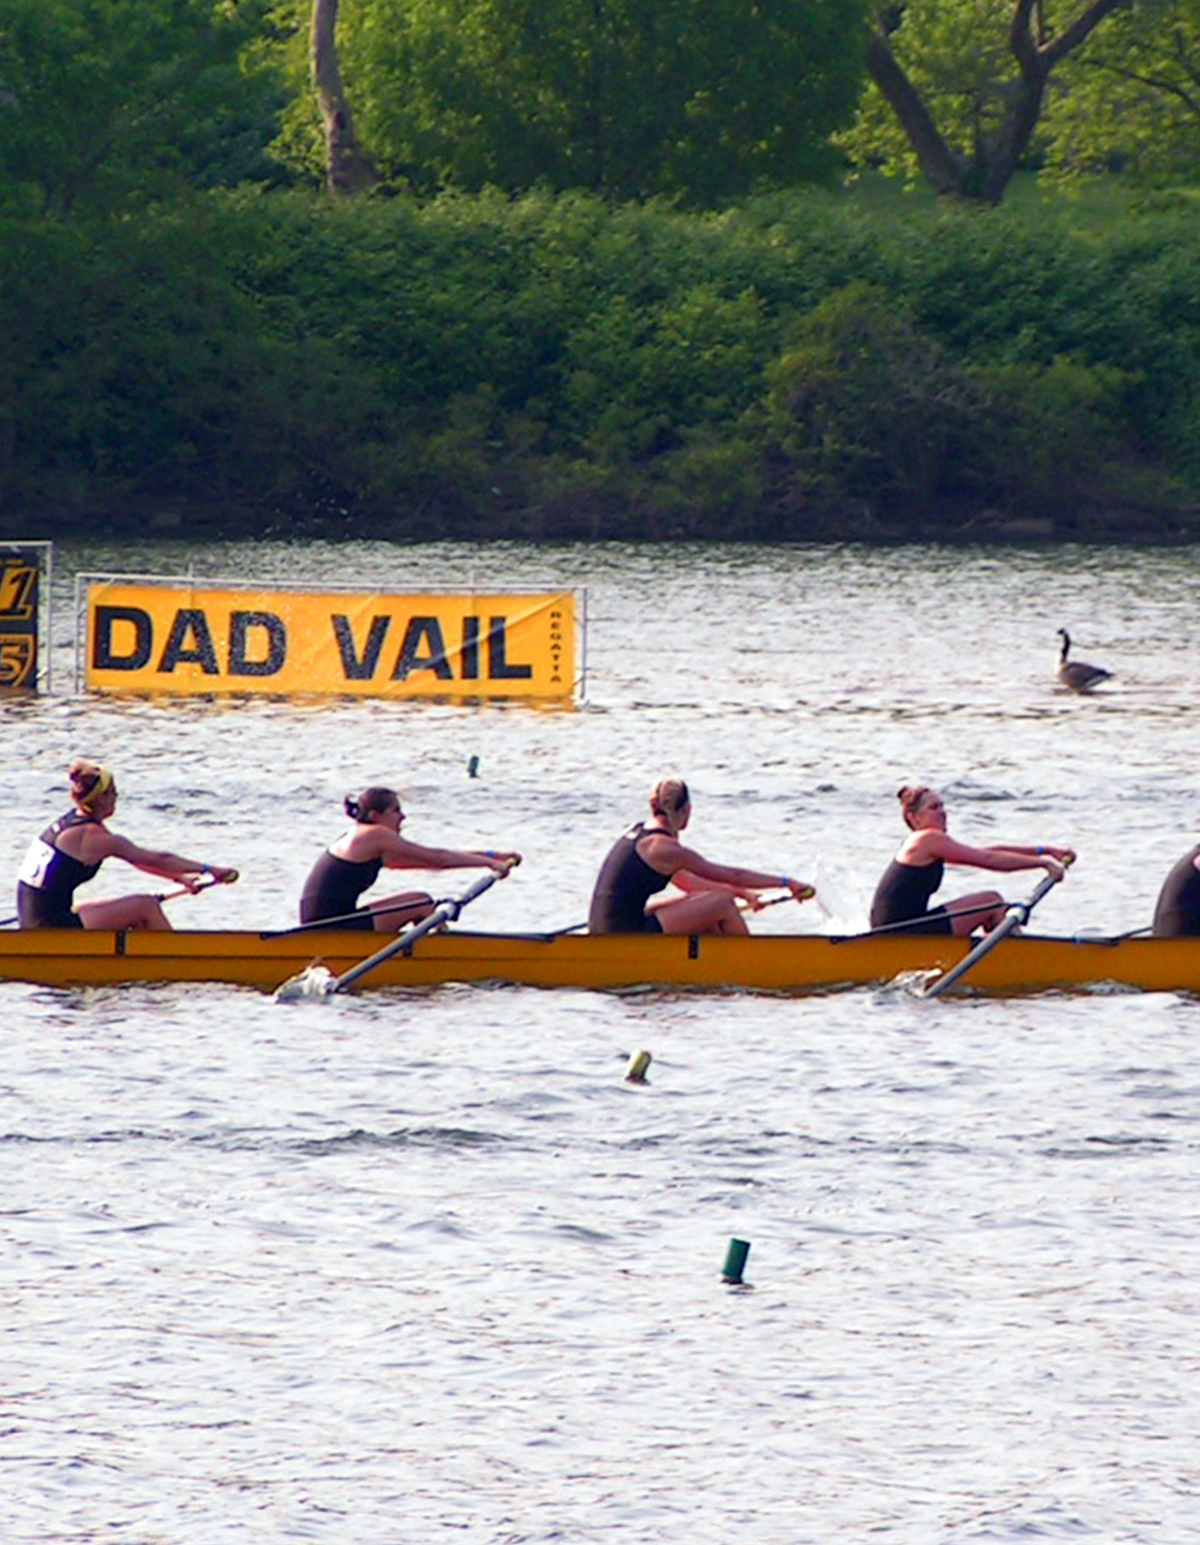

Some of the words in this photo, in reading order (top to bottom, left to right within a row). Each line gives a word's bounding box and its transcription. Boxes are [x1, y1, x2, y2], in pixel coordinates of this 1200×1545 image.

[92, 605, 287, 676] DAD
[331, 614, 533, 681] VAIL
[549, 611, 562, 683] REGATTA
